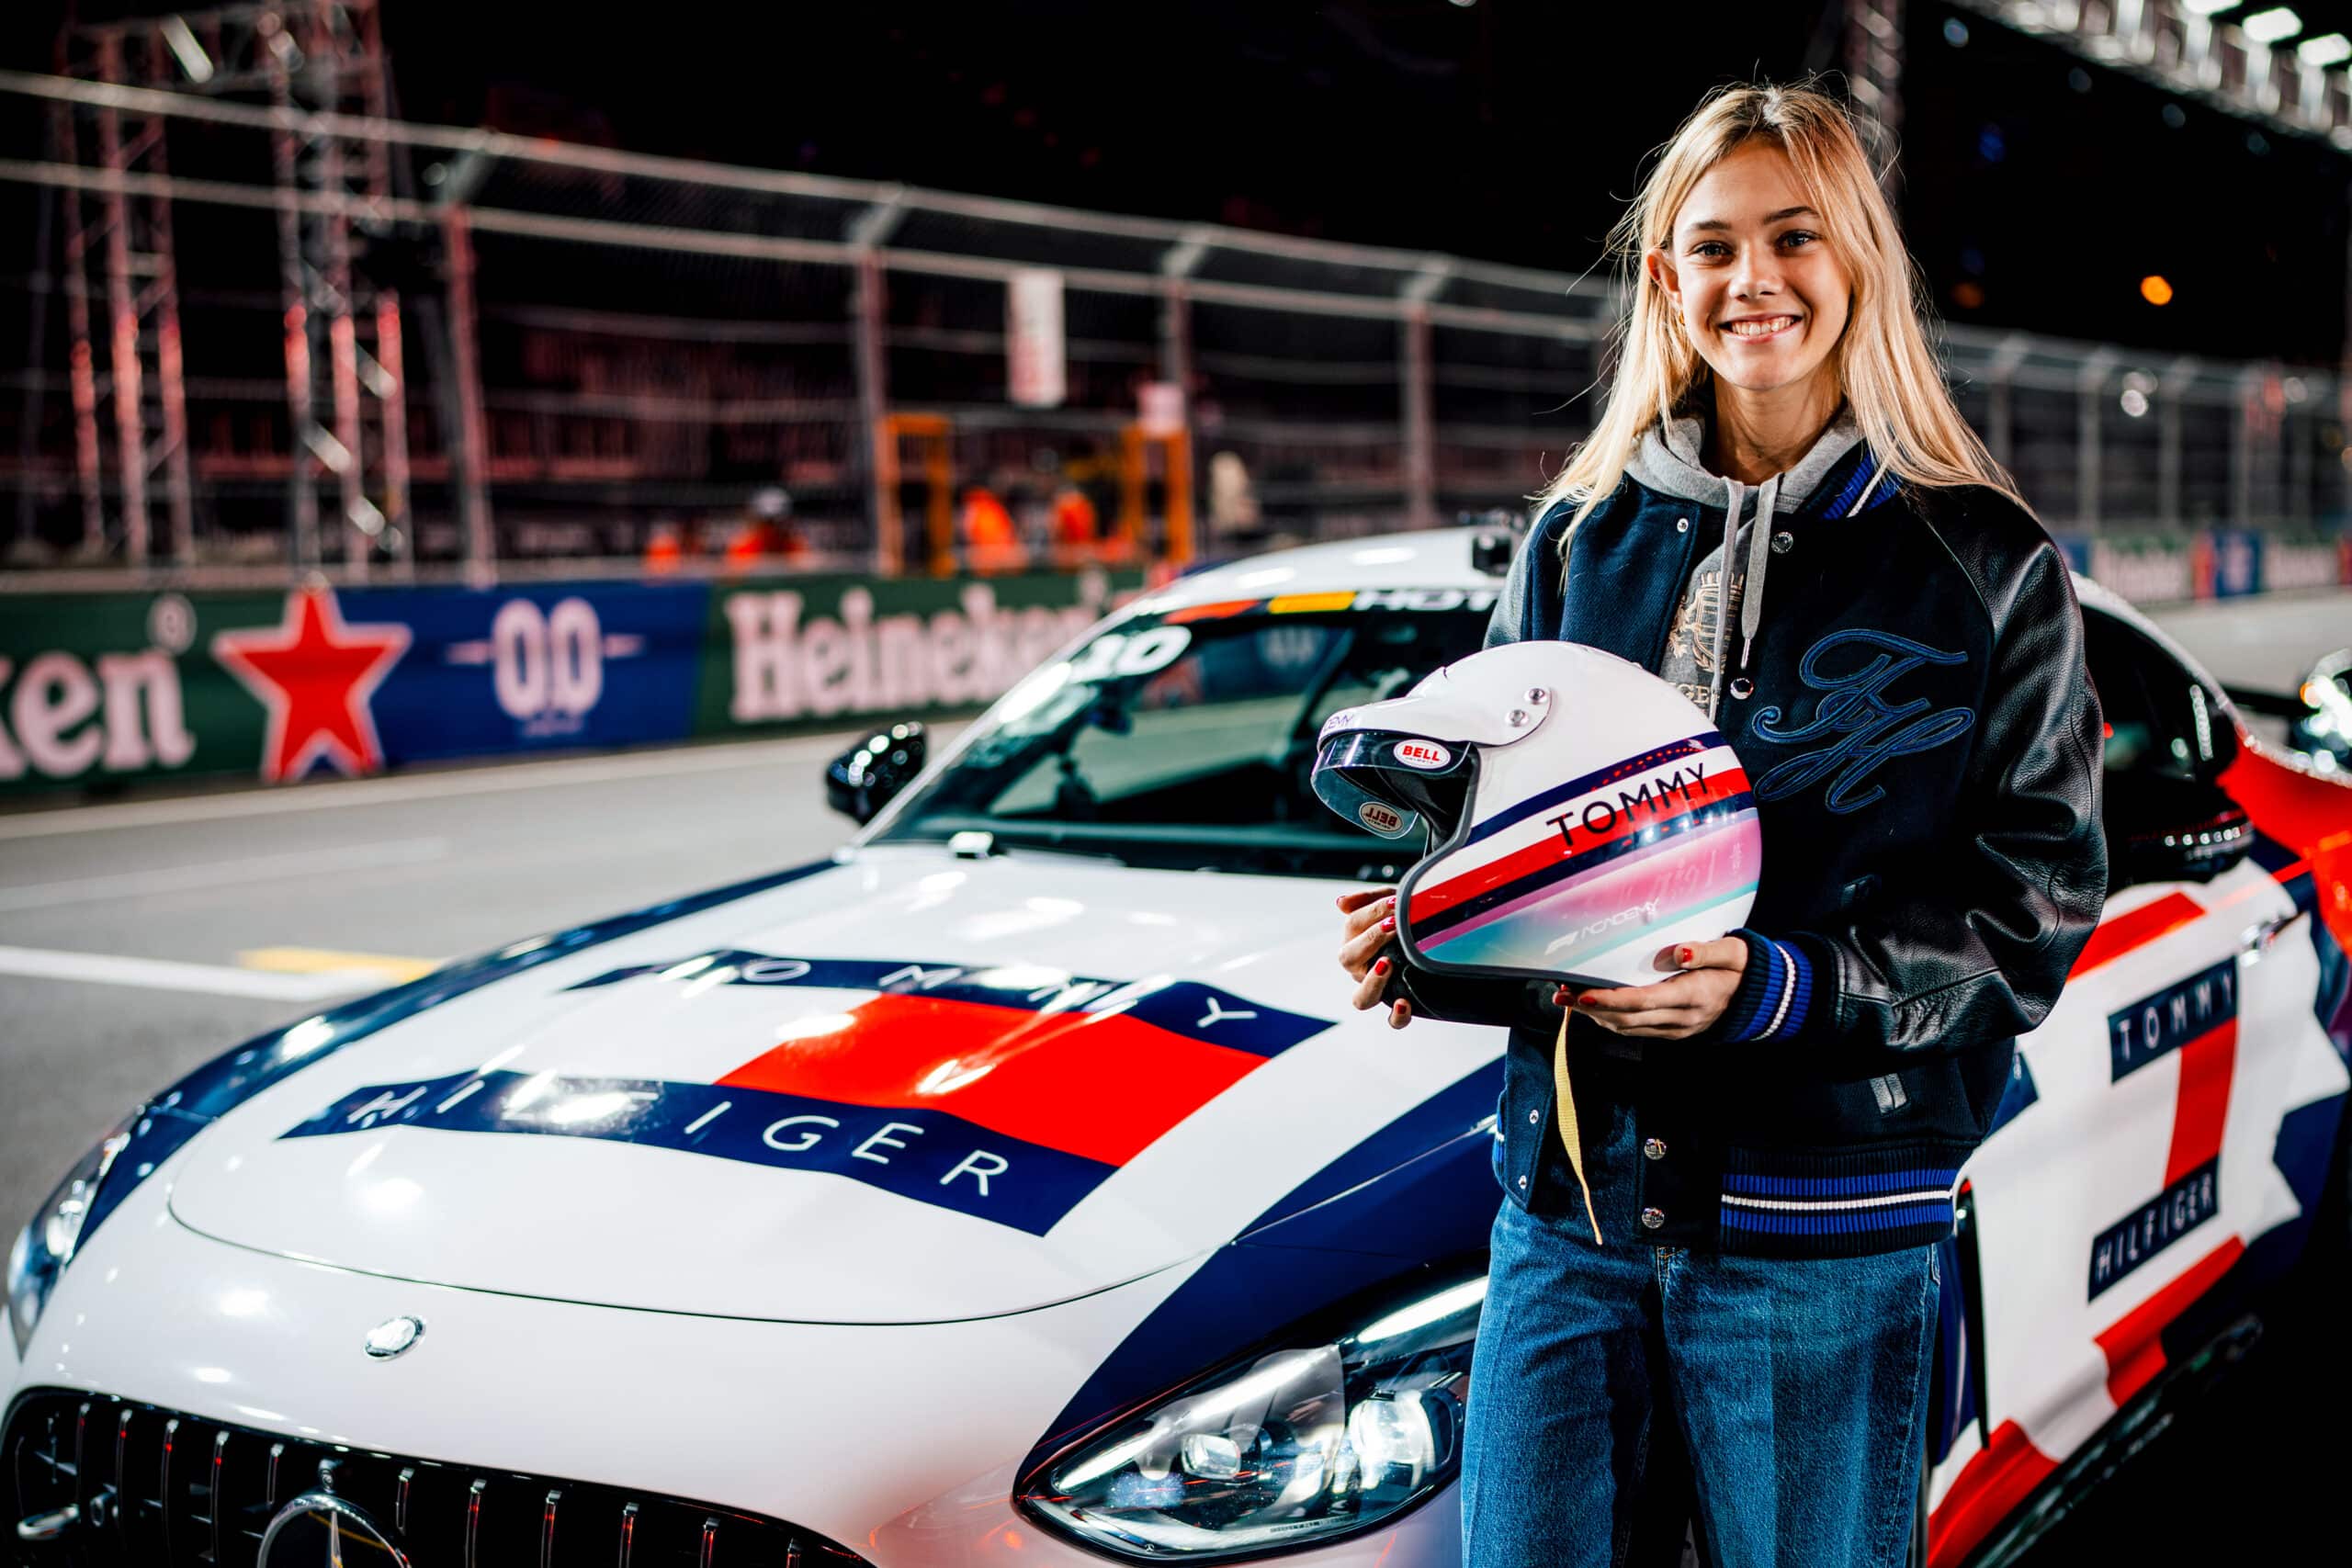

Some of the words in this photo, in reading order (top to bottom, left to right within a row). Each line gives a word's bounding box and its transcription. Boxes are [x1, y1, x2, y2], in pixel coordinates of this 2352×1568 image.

[0, 649, 197, 778] en
[1403, 745, 1441, 761] BELL
[1545, 762, 1708, 846] TOMMY
[2117, 971, 2233, 1061] TOMMY
[2094, 1173, 2212, 1283] HILFIGER
